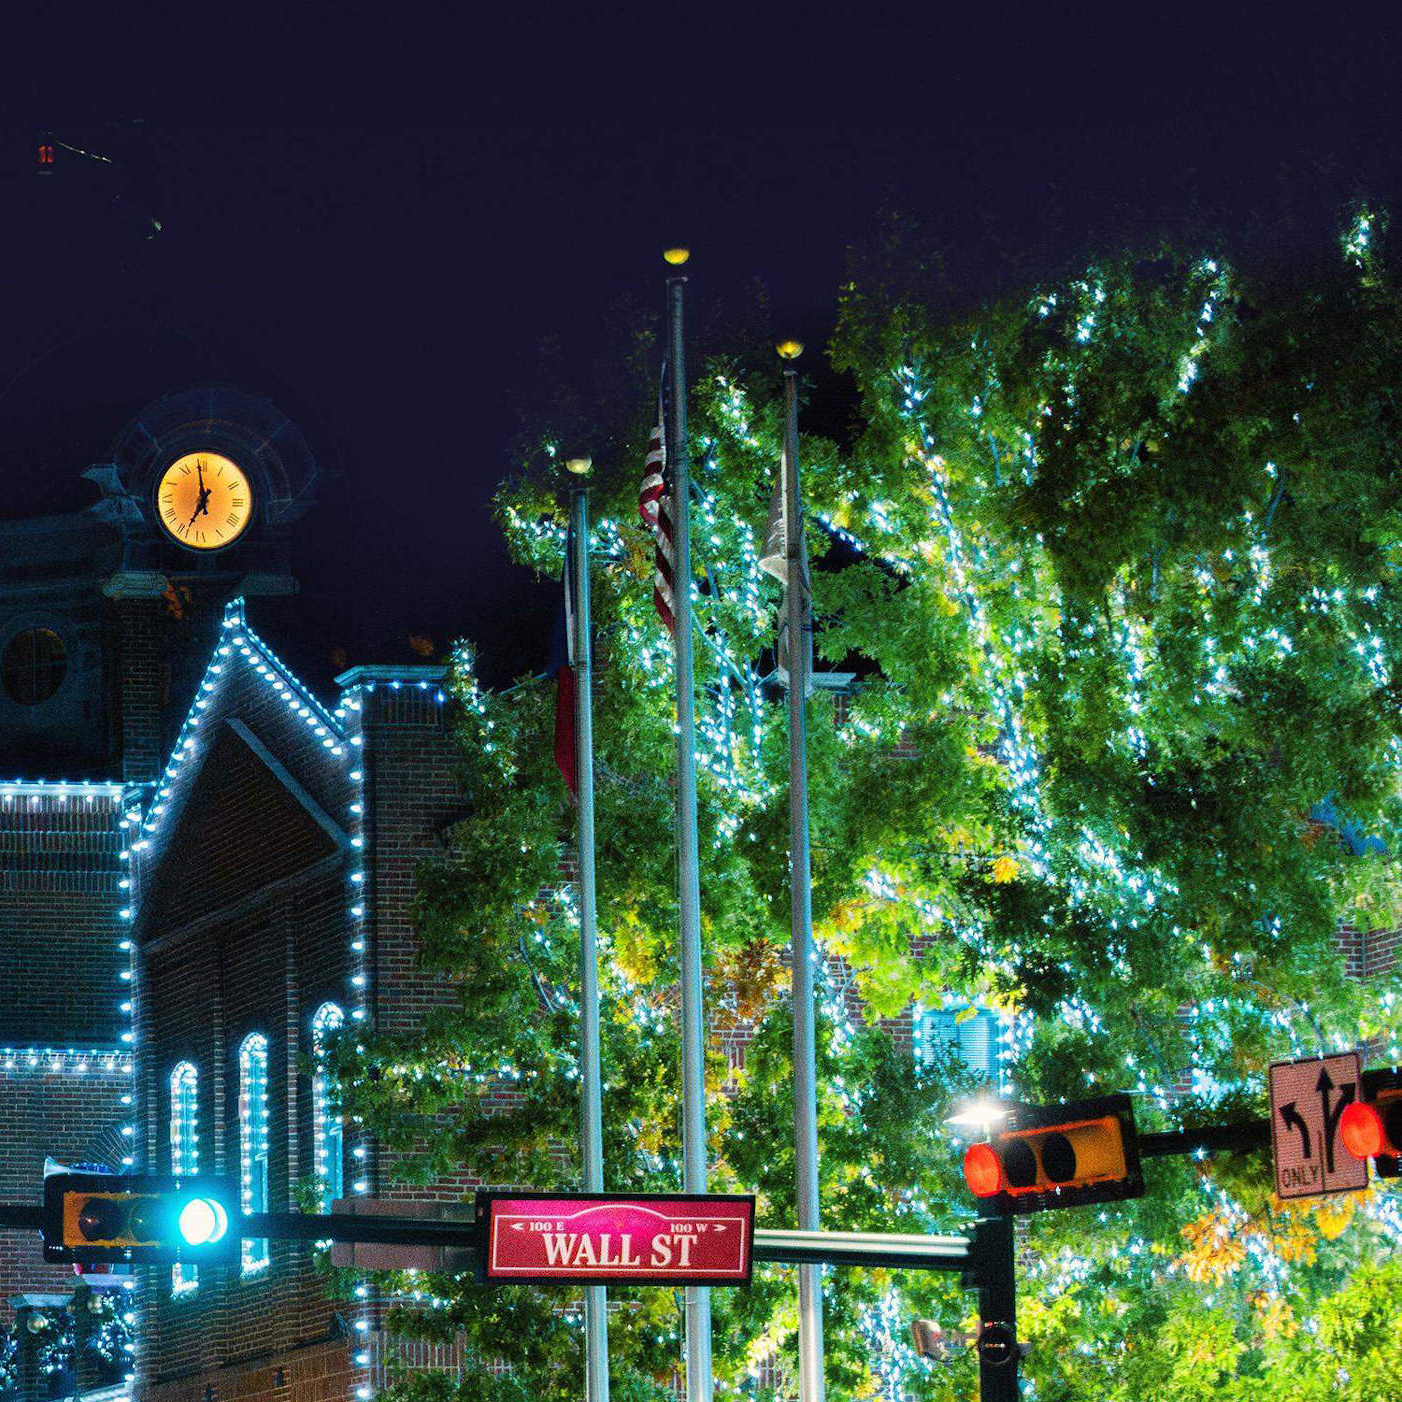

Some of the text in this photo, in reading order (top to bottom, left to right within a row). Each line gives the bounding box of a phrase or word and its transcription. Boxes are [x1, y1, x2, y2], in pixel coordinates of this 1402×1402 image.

[1281, 1166, 1319, 1188] ONLY
[529, 1221, 565, 1232] 100 E
[670, 1223, 709, 1233] 100 W
[542, 1233, 698, 1267] WALL ST
